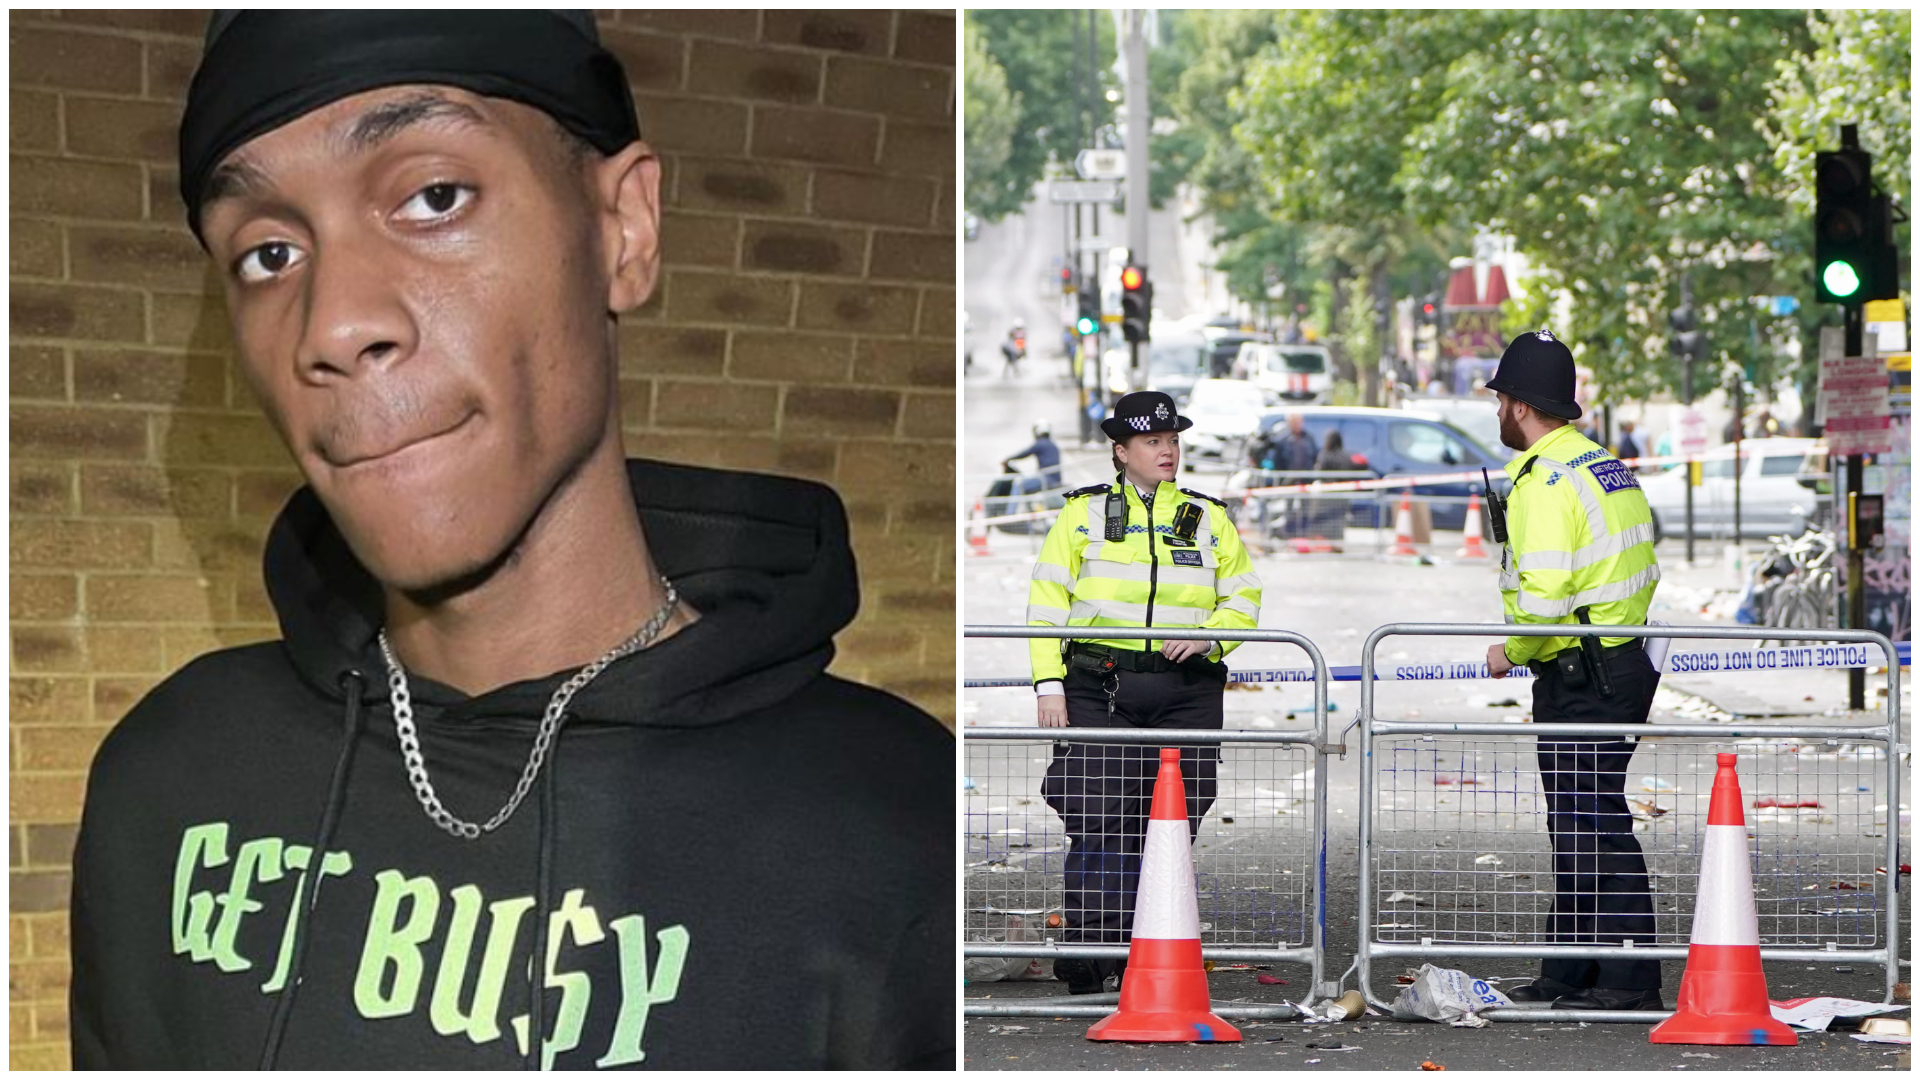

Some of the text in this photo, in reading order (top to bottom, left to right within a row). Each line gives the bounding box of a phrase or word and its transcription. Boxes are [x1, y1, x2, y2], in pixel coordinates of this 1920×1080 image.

[1671, 646, 1867, 672] POLICE LINE DO NOT CROSS
[1230, 672, 1262, 683] LINE
[1396, 665, 1444, 681] CROSS
[1450, 664, 1476, 679] NOT
[1506, 665, 1536, 678] INE
[172, 821, 353, 994] GET
